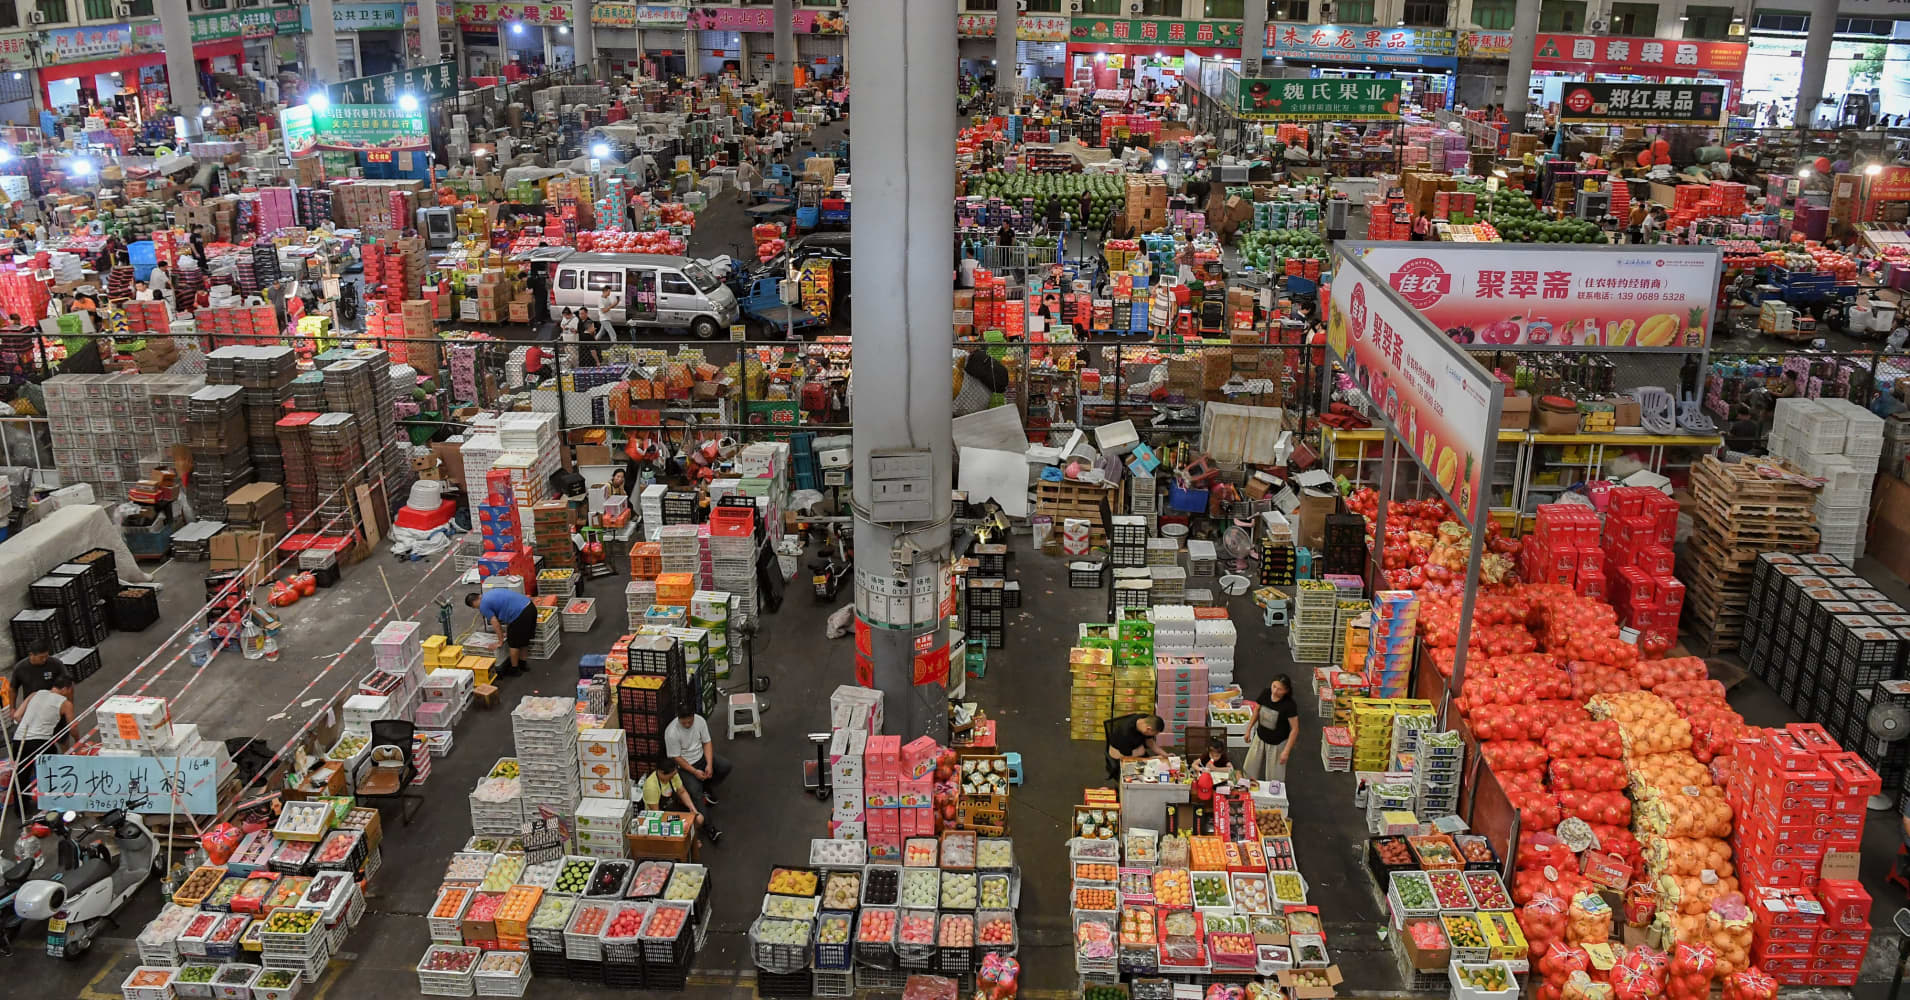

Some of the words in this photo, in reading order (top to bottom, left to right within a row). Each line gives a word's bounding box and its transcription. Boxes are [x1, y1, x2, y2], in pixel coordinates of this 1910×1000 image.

[333, 9, 395, 20] 公共卫生间
[473, 5, 567, 20] 开心果业
[1113, 21, 1213, 41] 新海果品
[342, 66, 451, 104] 小叶精品水果
[1283, 83, 1387, 100] 魏氏果业
[1609, 89, 1694, 110] 郑红果品
[1398, 273, 1441, 293] 佳农
[1475, 270, 1573, 299] 聚翠斋
[1618, 292, 1633, 300] 139
[1636, 292, 1659, 300] 0689
[1662, 293, 1685, 301] 5328
[1372, 311, 1403, 371] 聚翠斋
[916, 585, 931, 593] 012
[44, 765, 192, 800] 场地出租
